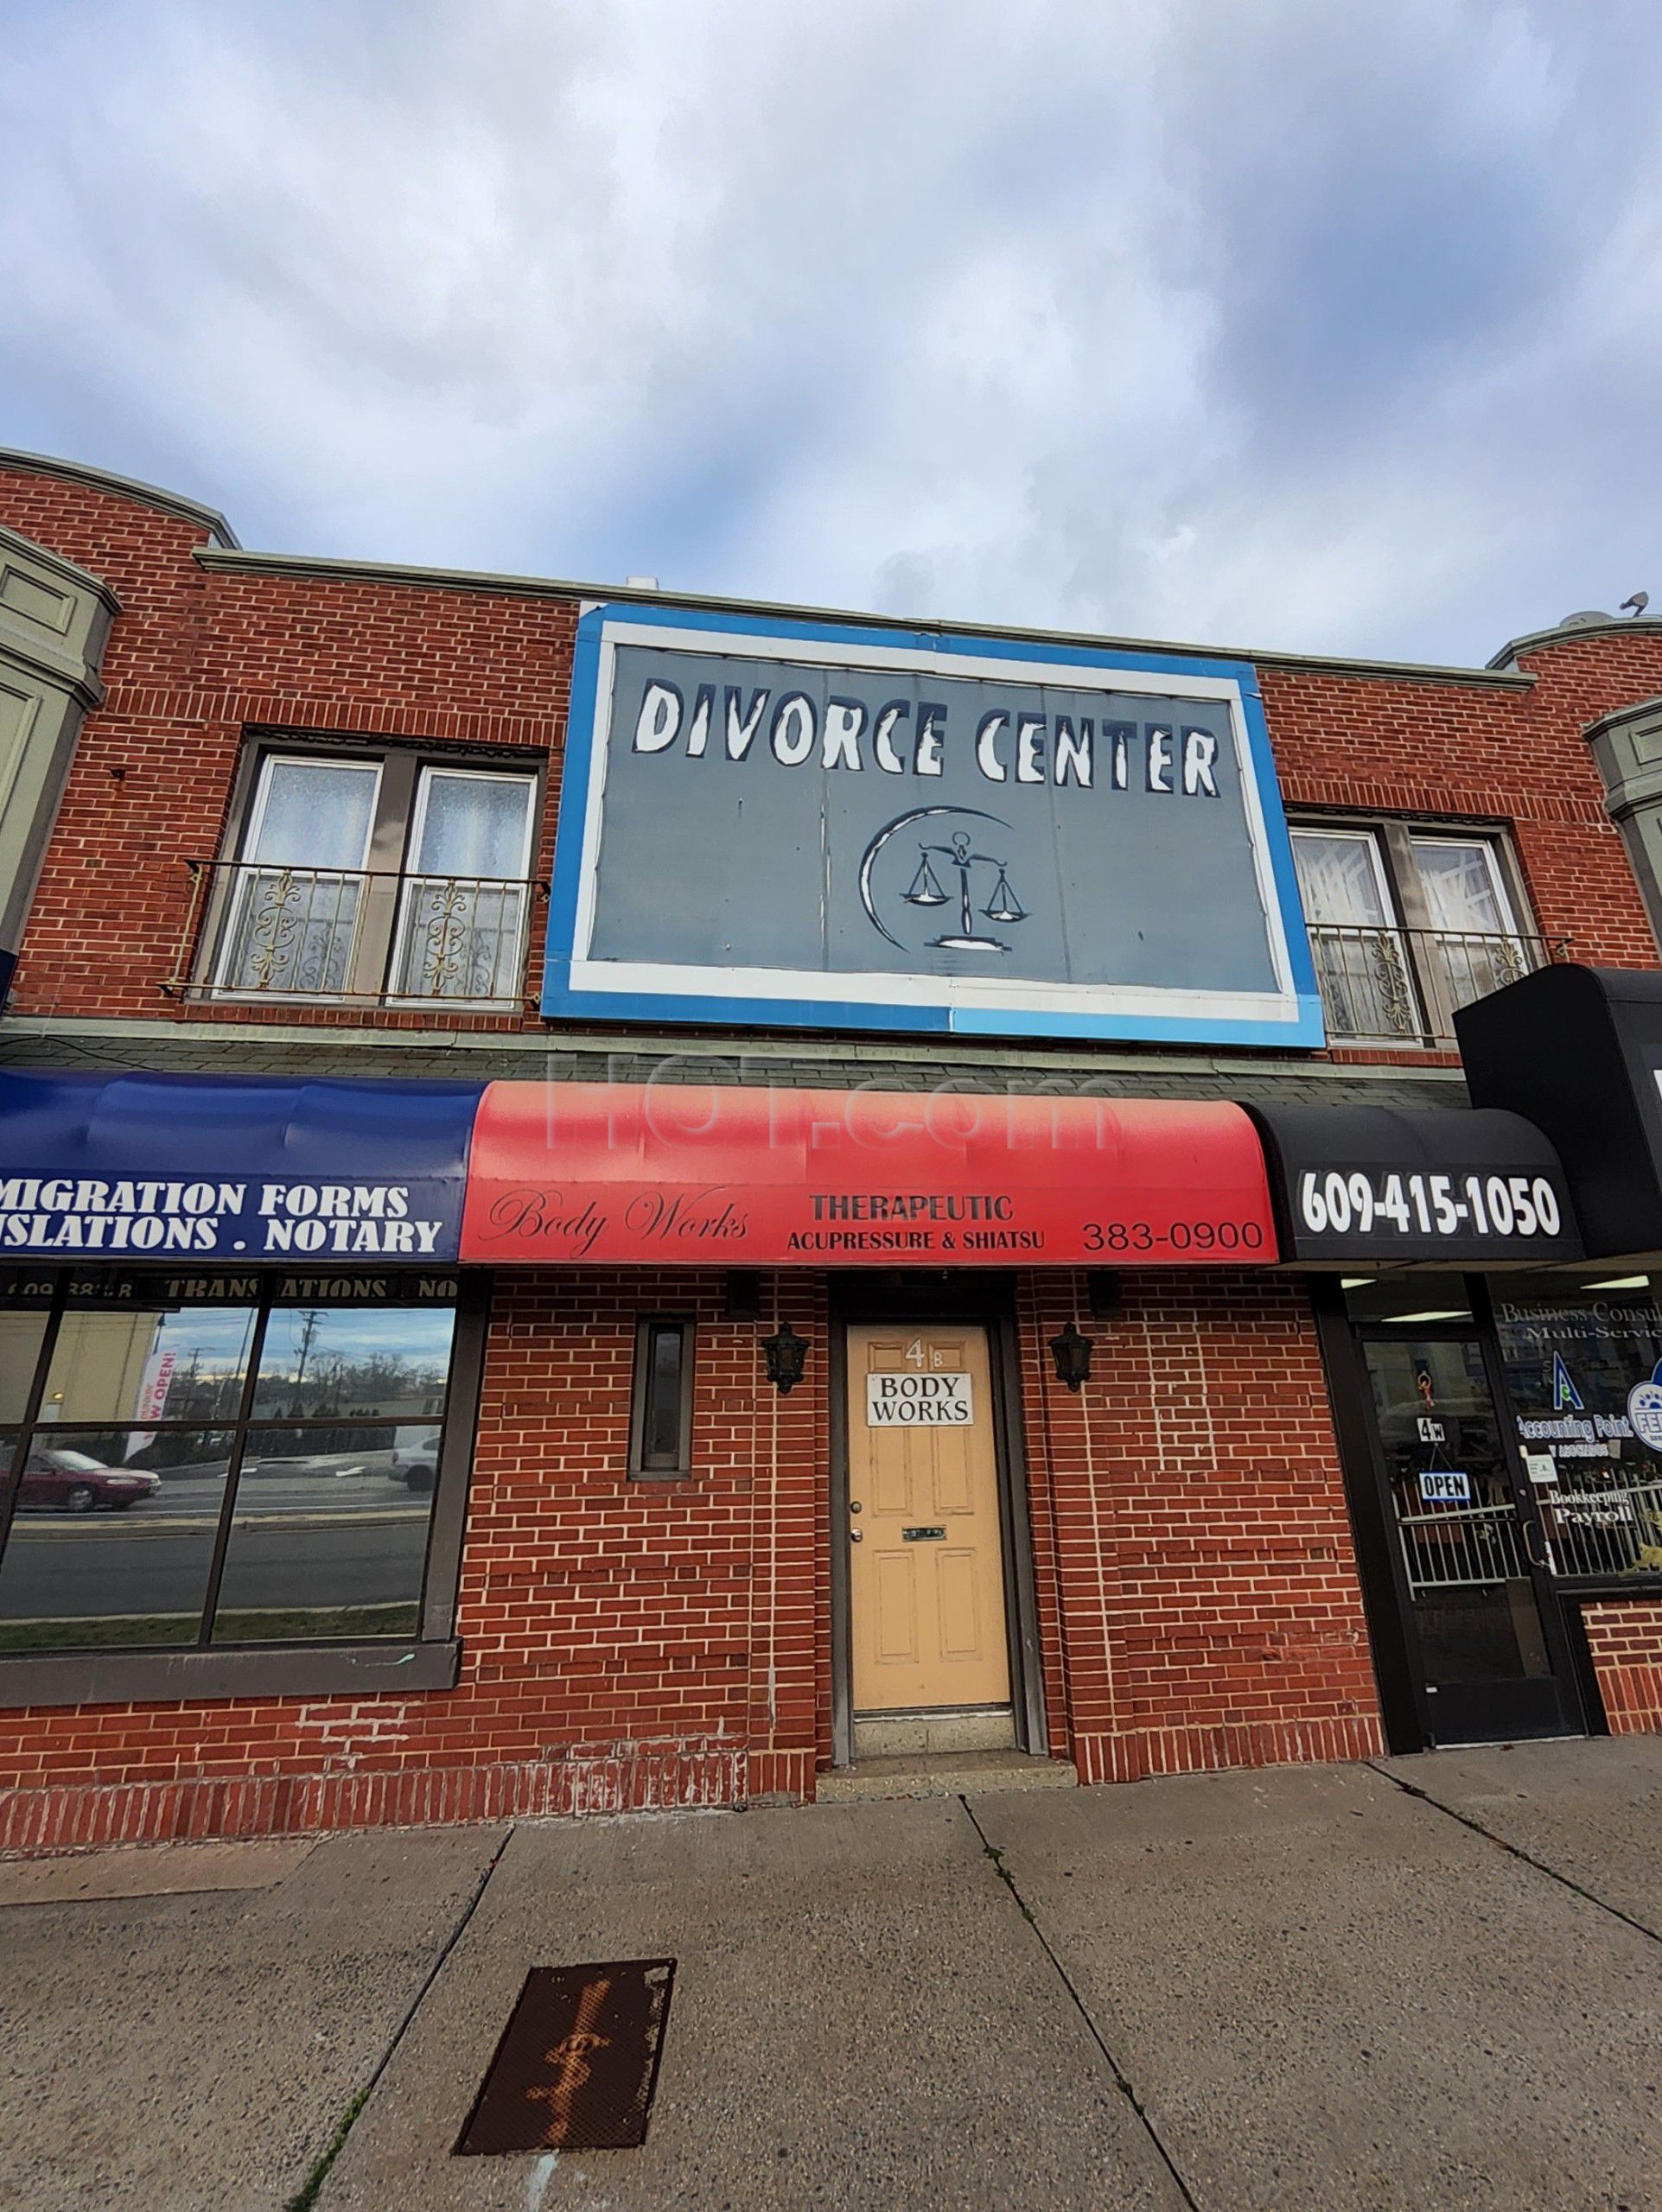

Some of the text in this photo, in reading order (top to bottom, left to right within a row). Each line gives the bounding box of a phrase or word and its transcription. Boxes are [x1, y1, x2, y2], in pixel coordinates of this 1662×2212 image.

[632, 677, 1222, 798] DIVORCE CENTER
[258, 1185, 409, 1218] FORMS
[809, 1194, 1014, 1221] THERAPEUTIC
[1302, 1172, 1561, 1236] 609-415-1050
[0, 1214, 220, 1250] SLATIONS
[264, 1219, 443, 1253] NOTARY
[478, 1185, 750, 1259] Body Works
[786, 1230, 1046, 1250] ACUPRESSURE & SHIATSU
[1082, 1221, 1264, 1251] 383-0900
[1500, 1302, 1588, 1323] Business
[881, 1377, 960, 1398] BODY
[872, 1401, 968, 1421] WORKS
[1517, 1414, 1595, 1443] Accounting
[1424, 1476, 1466, 1497] OPEN
[1550, 1489, 1630, 1506] Bookkeeping
[1554, 1506, 1633, 1525] Payroll
